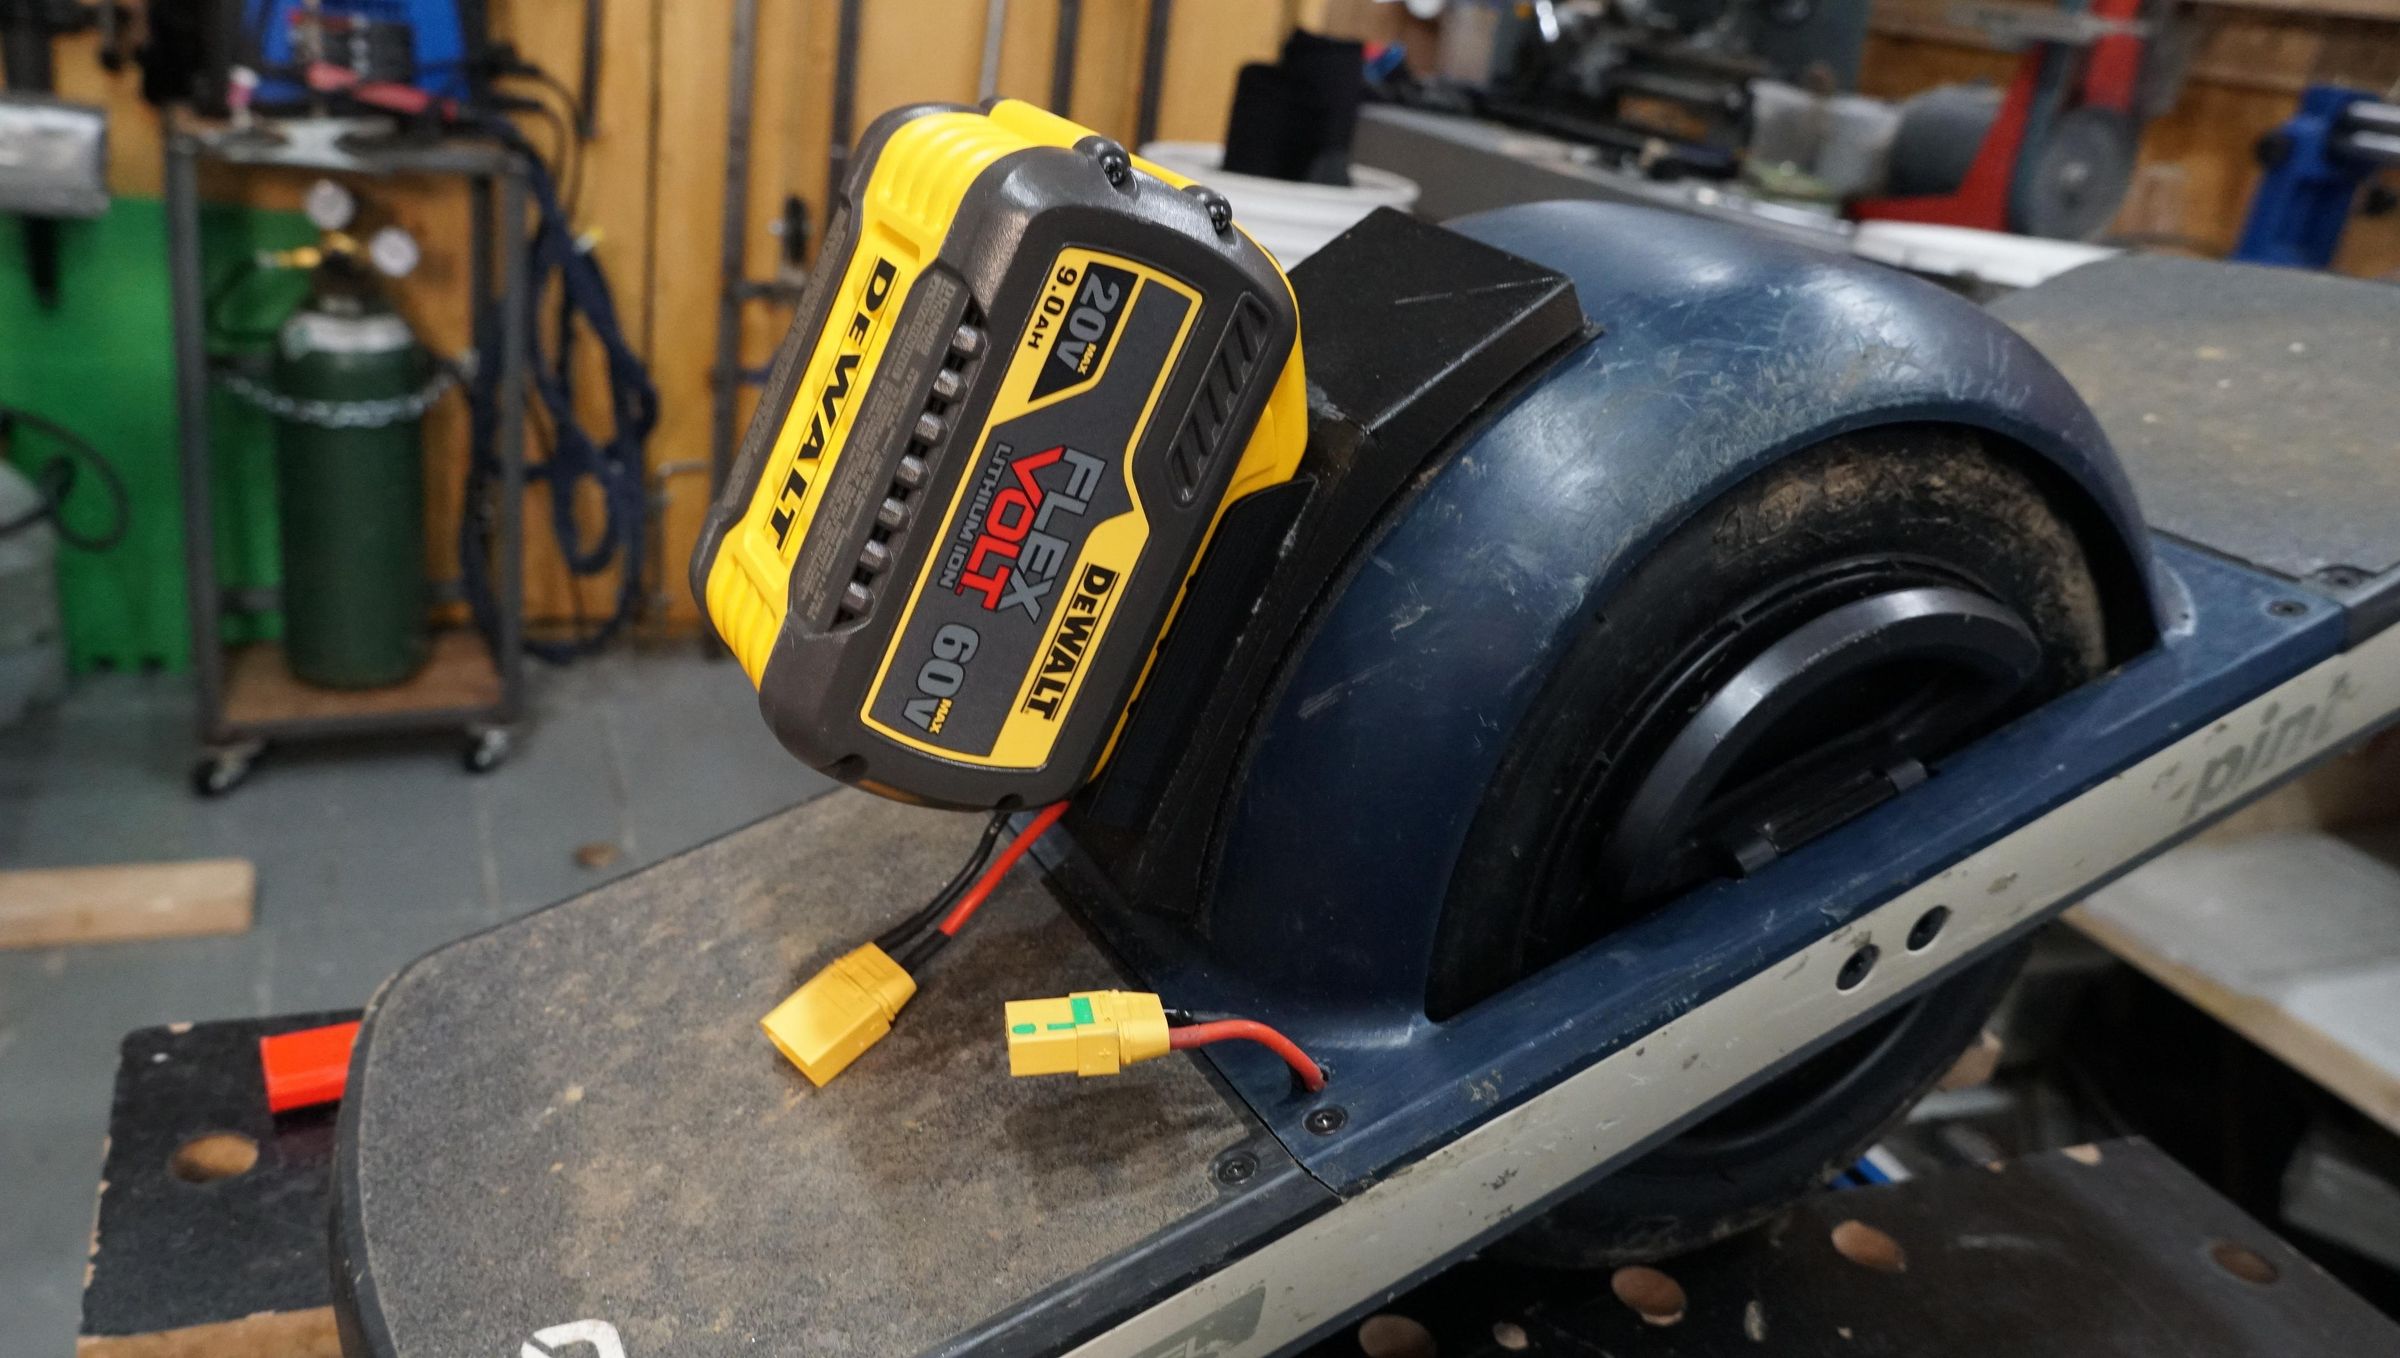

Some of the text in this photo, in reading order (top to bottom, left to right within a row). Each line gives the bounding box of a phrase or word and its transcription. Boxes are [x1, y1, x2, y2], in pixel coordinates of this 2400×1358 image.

[1056, 272, 1120, 371] 20V
[1077, 342, 1097, 375] MAX
[770, 257, 897, 551] DEWALT
[938, 442, 1013, 589] LITHIUM ION
[960, 444, 1066, 612] VOLT
[998, 447, 1107, 624] FLEX
[902, 622, 980, 732] 60V
[1027, 563, 1117, 720] DEWALT
[929, 698, 952, 734] MAX
